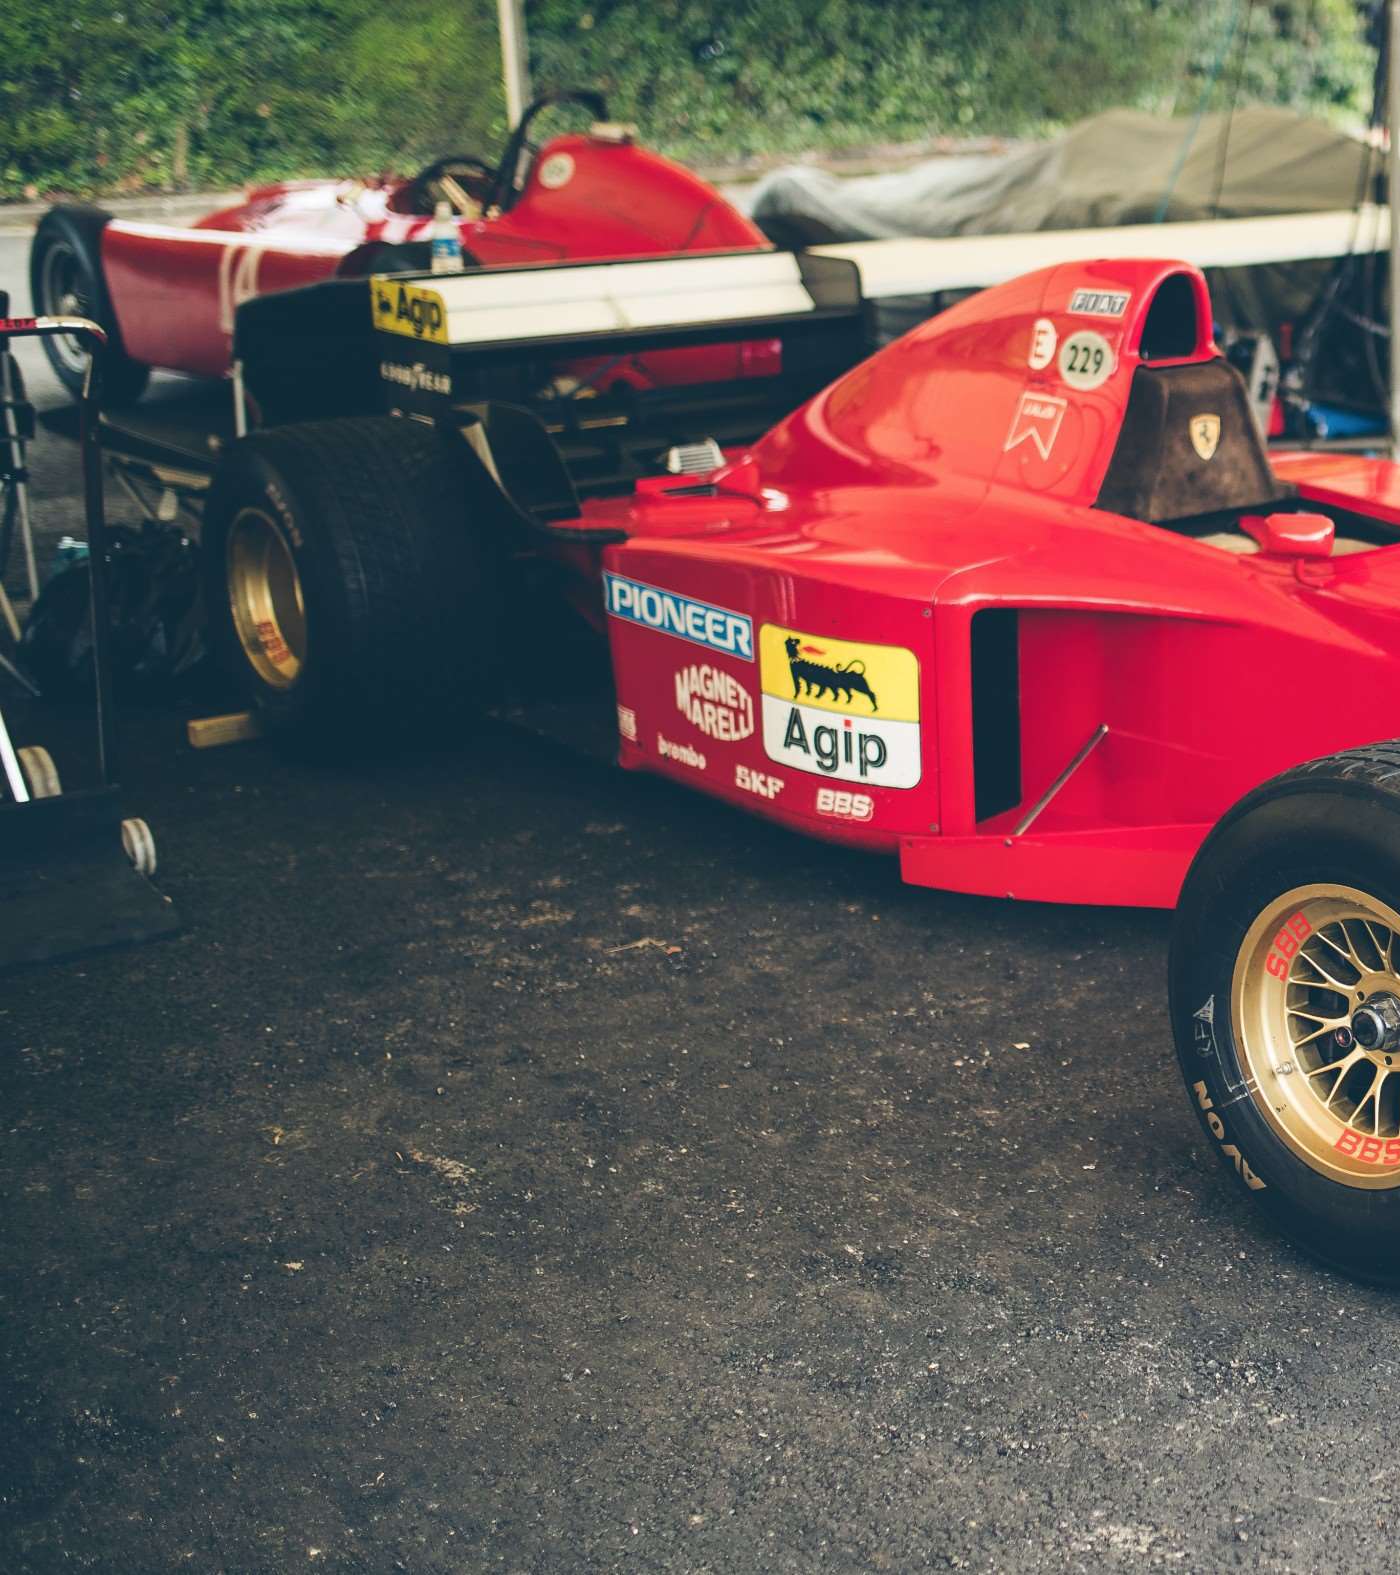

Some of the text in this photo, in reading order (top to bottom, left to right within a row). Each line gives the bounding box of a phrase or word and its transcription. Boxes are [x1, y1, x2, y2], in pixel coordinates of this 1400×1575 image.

[396, 284, 442, 337] Agip
[1072, 292, 1125, 316] FIAT
[1067, 344, 1105, 375] 229
[611, 579, 752, 657] PIONEER
[657, 731, 707, 770] brembo
[783, 706, 888, 777] Agip
[735, 764, 785, 800] SKF
[816, 787, 873, 821] BBS
[1265, 911, 1313, 982] BBS
[1192, 1079, 1267, 1191] AVON
